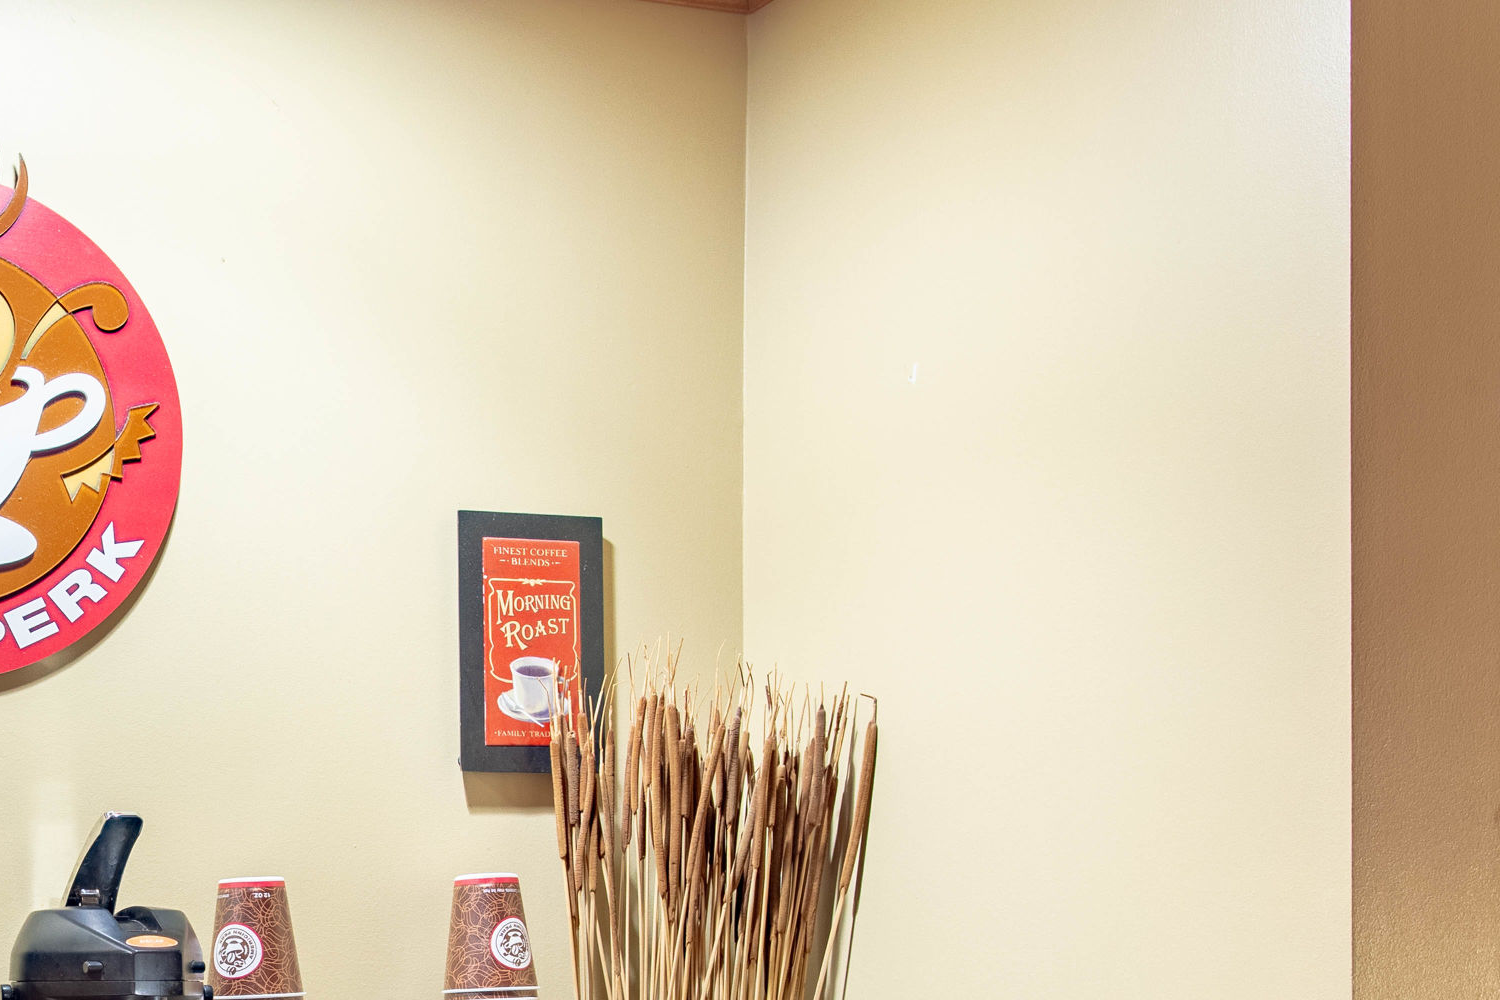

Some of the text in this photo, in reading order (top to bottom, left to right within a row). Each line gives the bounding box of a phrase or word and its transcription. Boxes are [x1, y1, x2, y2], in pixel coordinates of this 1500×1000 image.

[493, 546, 568, 558] FINEST COFFEE
[511, 557, 550, 567] BLENDS
[496, 589, 572, 625] MORNING
[499, 617, 570, 651] ROAST
[497, 729, 527, 738] FAMILY
